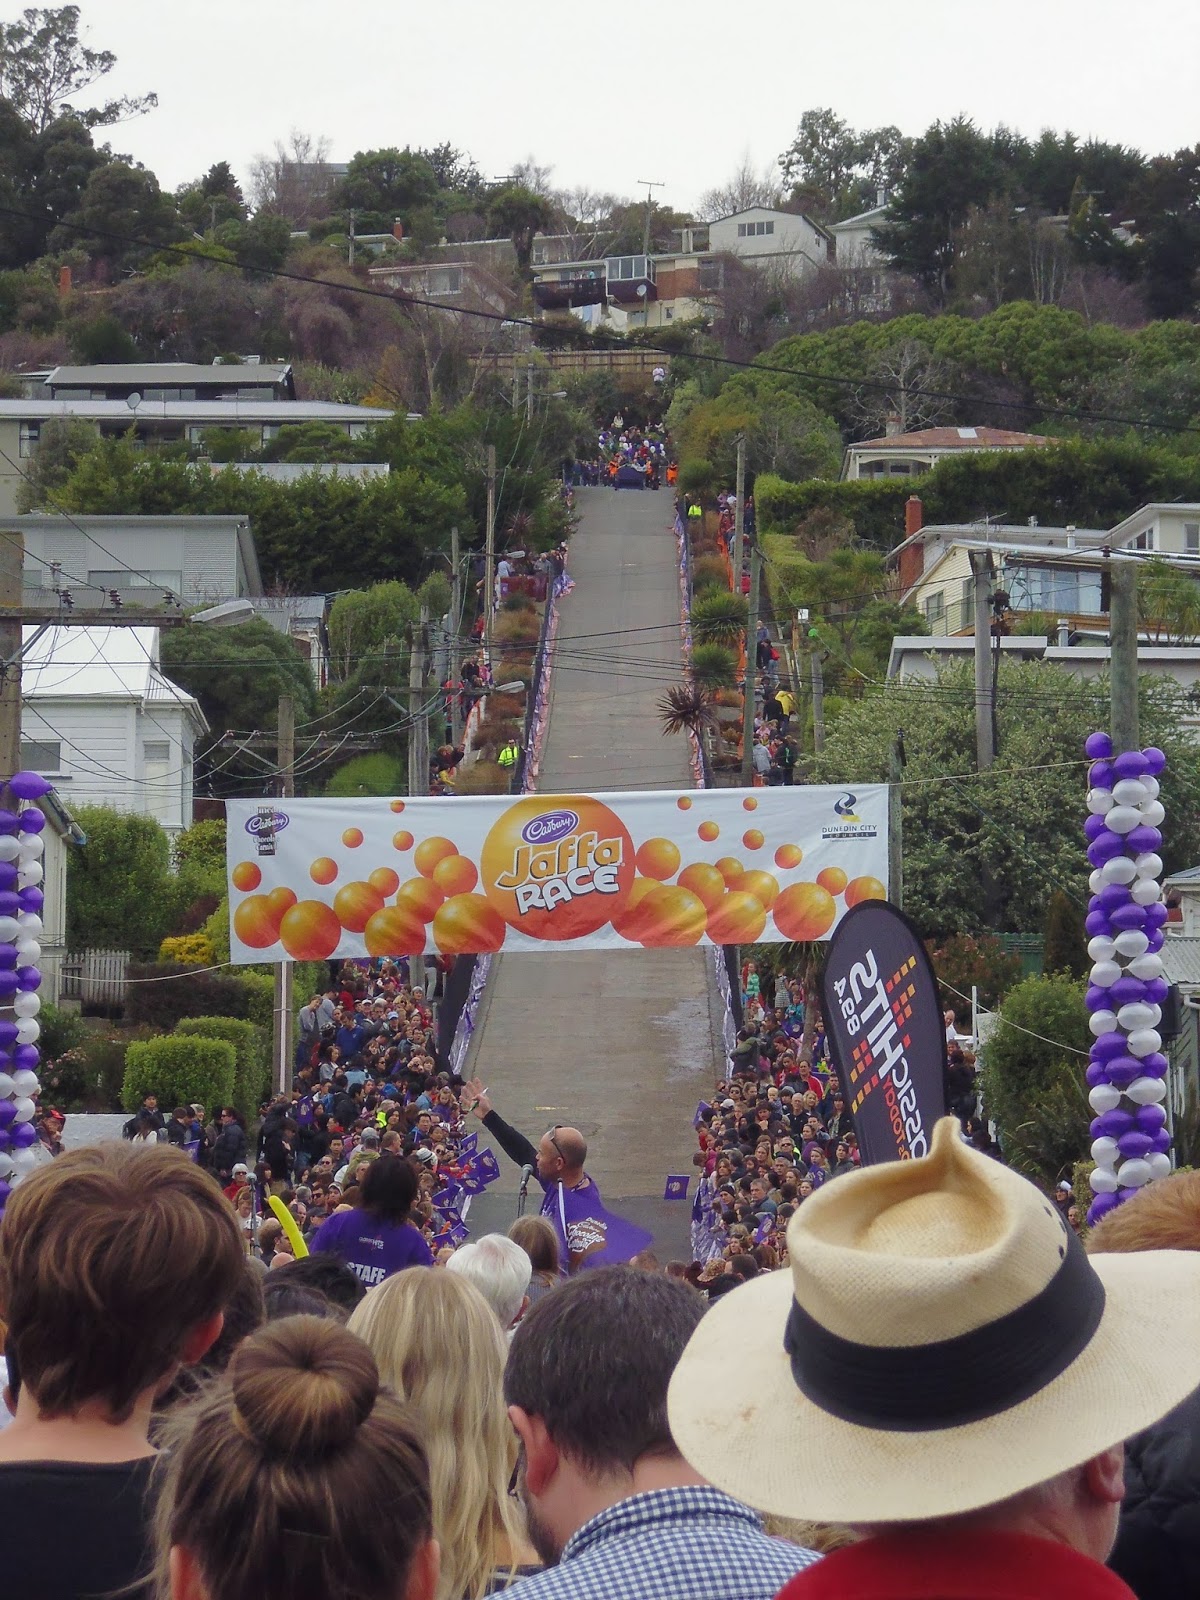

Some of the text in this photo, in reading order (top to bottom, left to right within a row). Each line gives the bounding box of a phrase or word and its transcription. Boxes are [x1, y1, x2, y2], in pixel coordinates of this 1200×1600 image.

[248, 817, 285, 833] Cadbury
[526, 818, 572, 840] Cadbury
[822, 825, 857, 833] DUNEDIN
[494, 831, 623, 890] Jaffa
[514, 865, 620, 916] RACE
